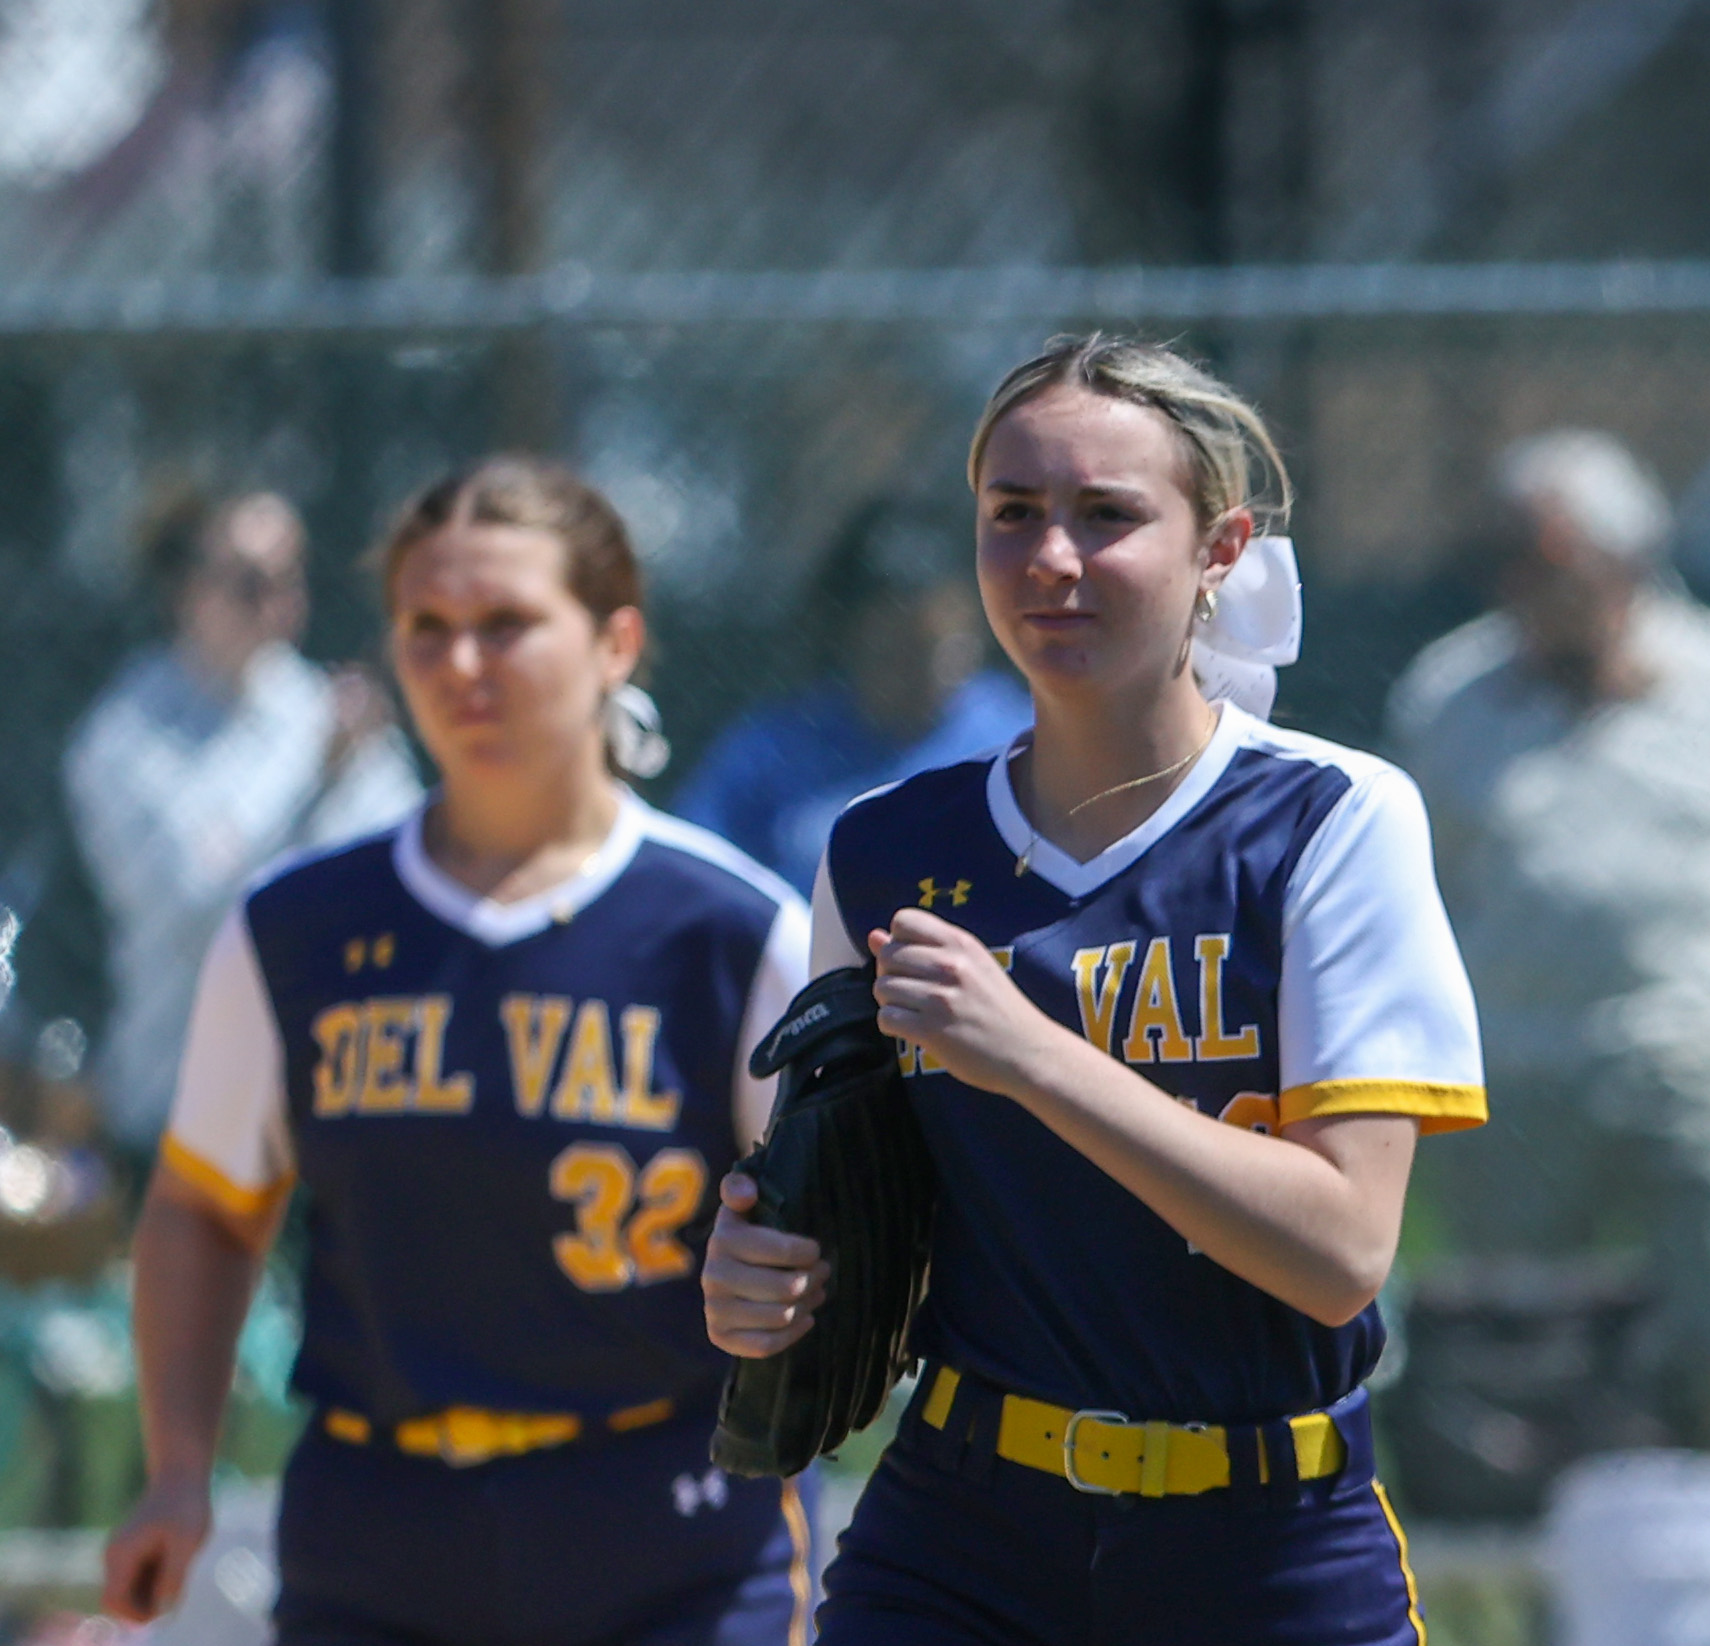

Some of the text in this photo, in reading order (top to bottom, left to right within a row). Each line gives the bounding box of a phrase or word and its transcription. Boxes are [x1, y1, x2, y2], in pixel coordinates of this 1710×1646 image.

[312, 995, 683, 1132] DEL VAL
[1071, 933, 1260, 1063] VAL
[549, 1141, 707, 1293] 32
